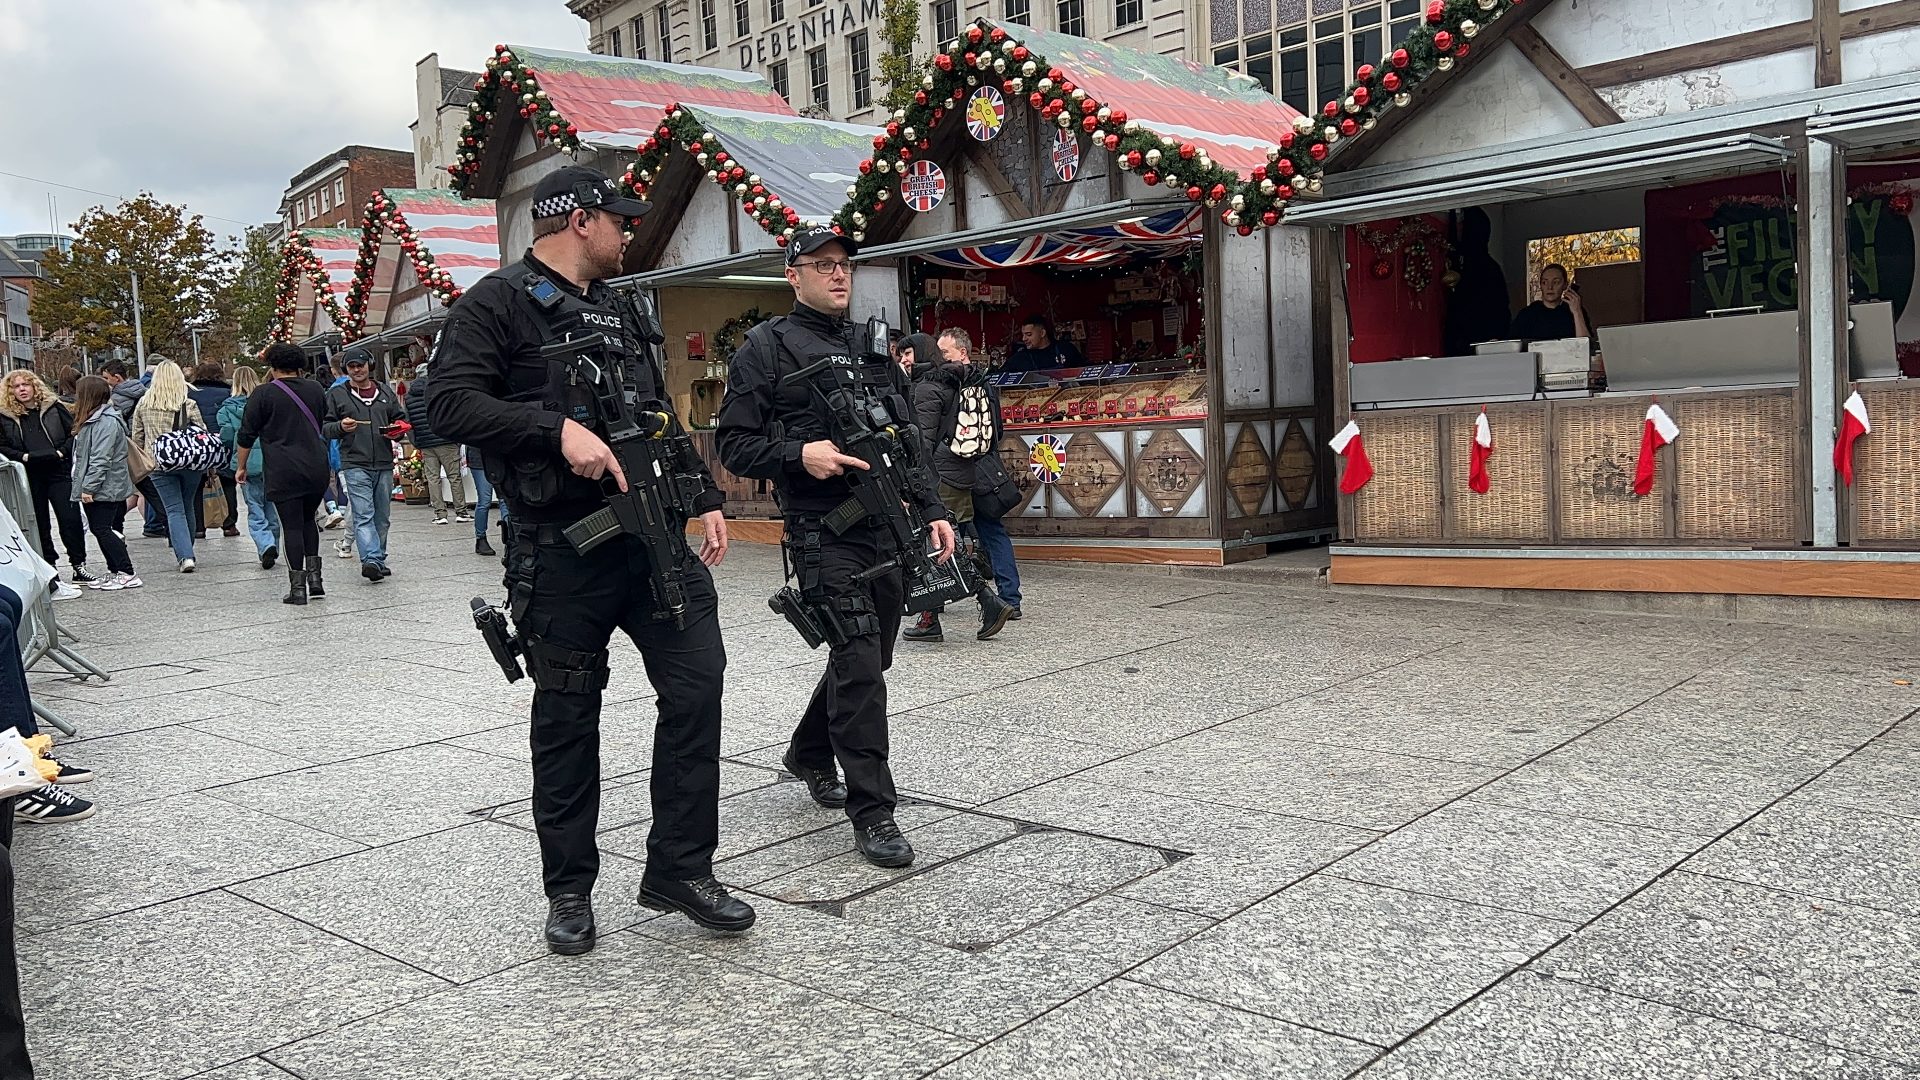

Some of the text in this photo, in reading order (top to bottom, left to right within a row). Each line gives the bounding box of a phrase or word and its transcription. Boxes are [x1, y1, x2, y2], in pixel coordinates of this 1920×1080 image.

[910, 175, 935, 183] GREAT
[907, 181, 938, 190] BRITISH
[908, 189, 937, 197] CHEESE
[1727, 200, 1882, 266] FILY
[1705, 247, 1879, 309] VEGN
[582, 313, 622, 328] POLICE
[830, 355, 865, 365] POLIE
[910, 588, 929, 597] HOUSE
[928, 585, 937, 593] OF
